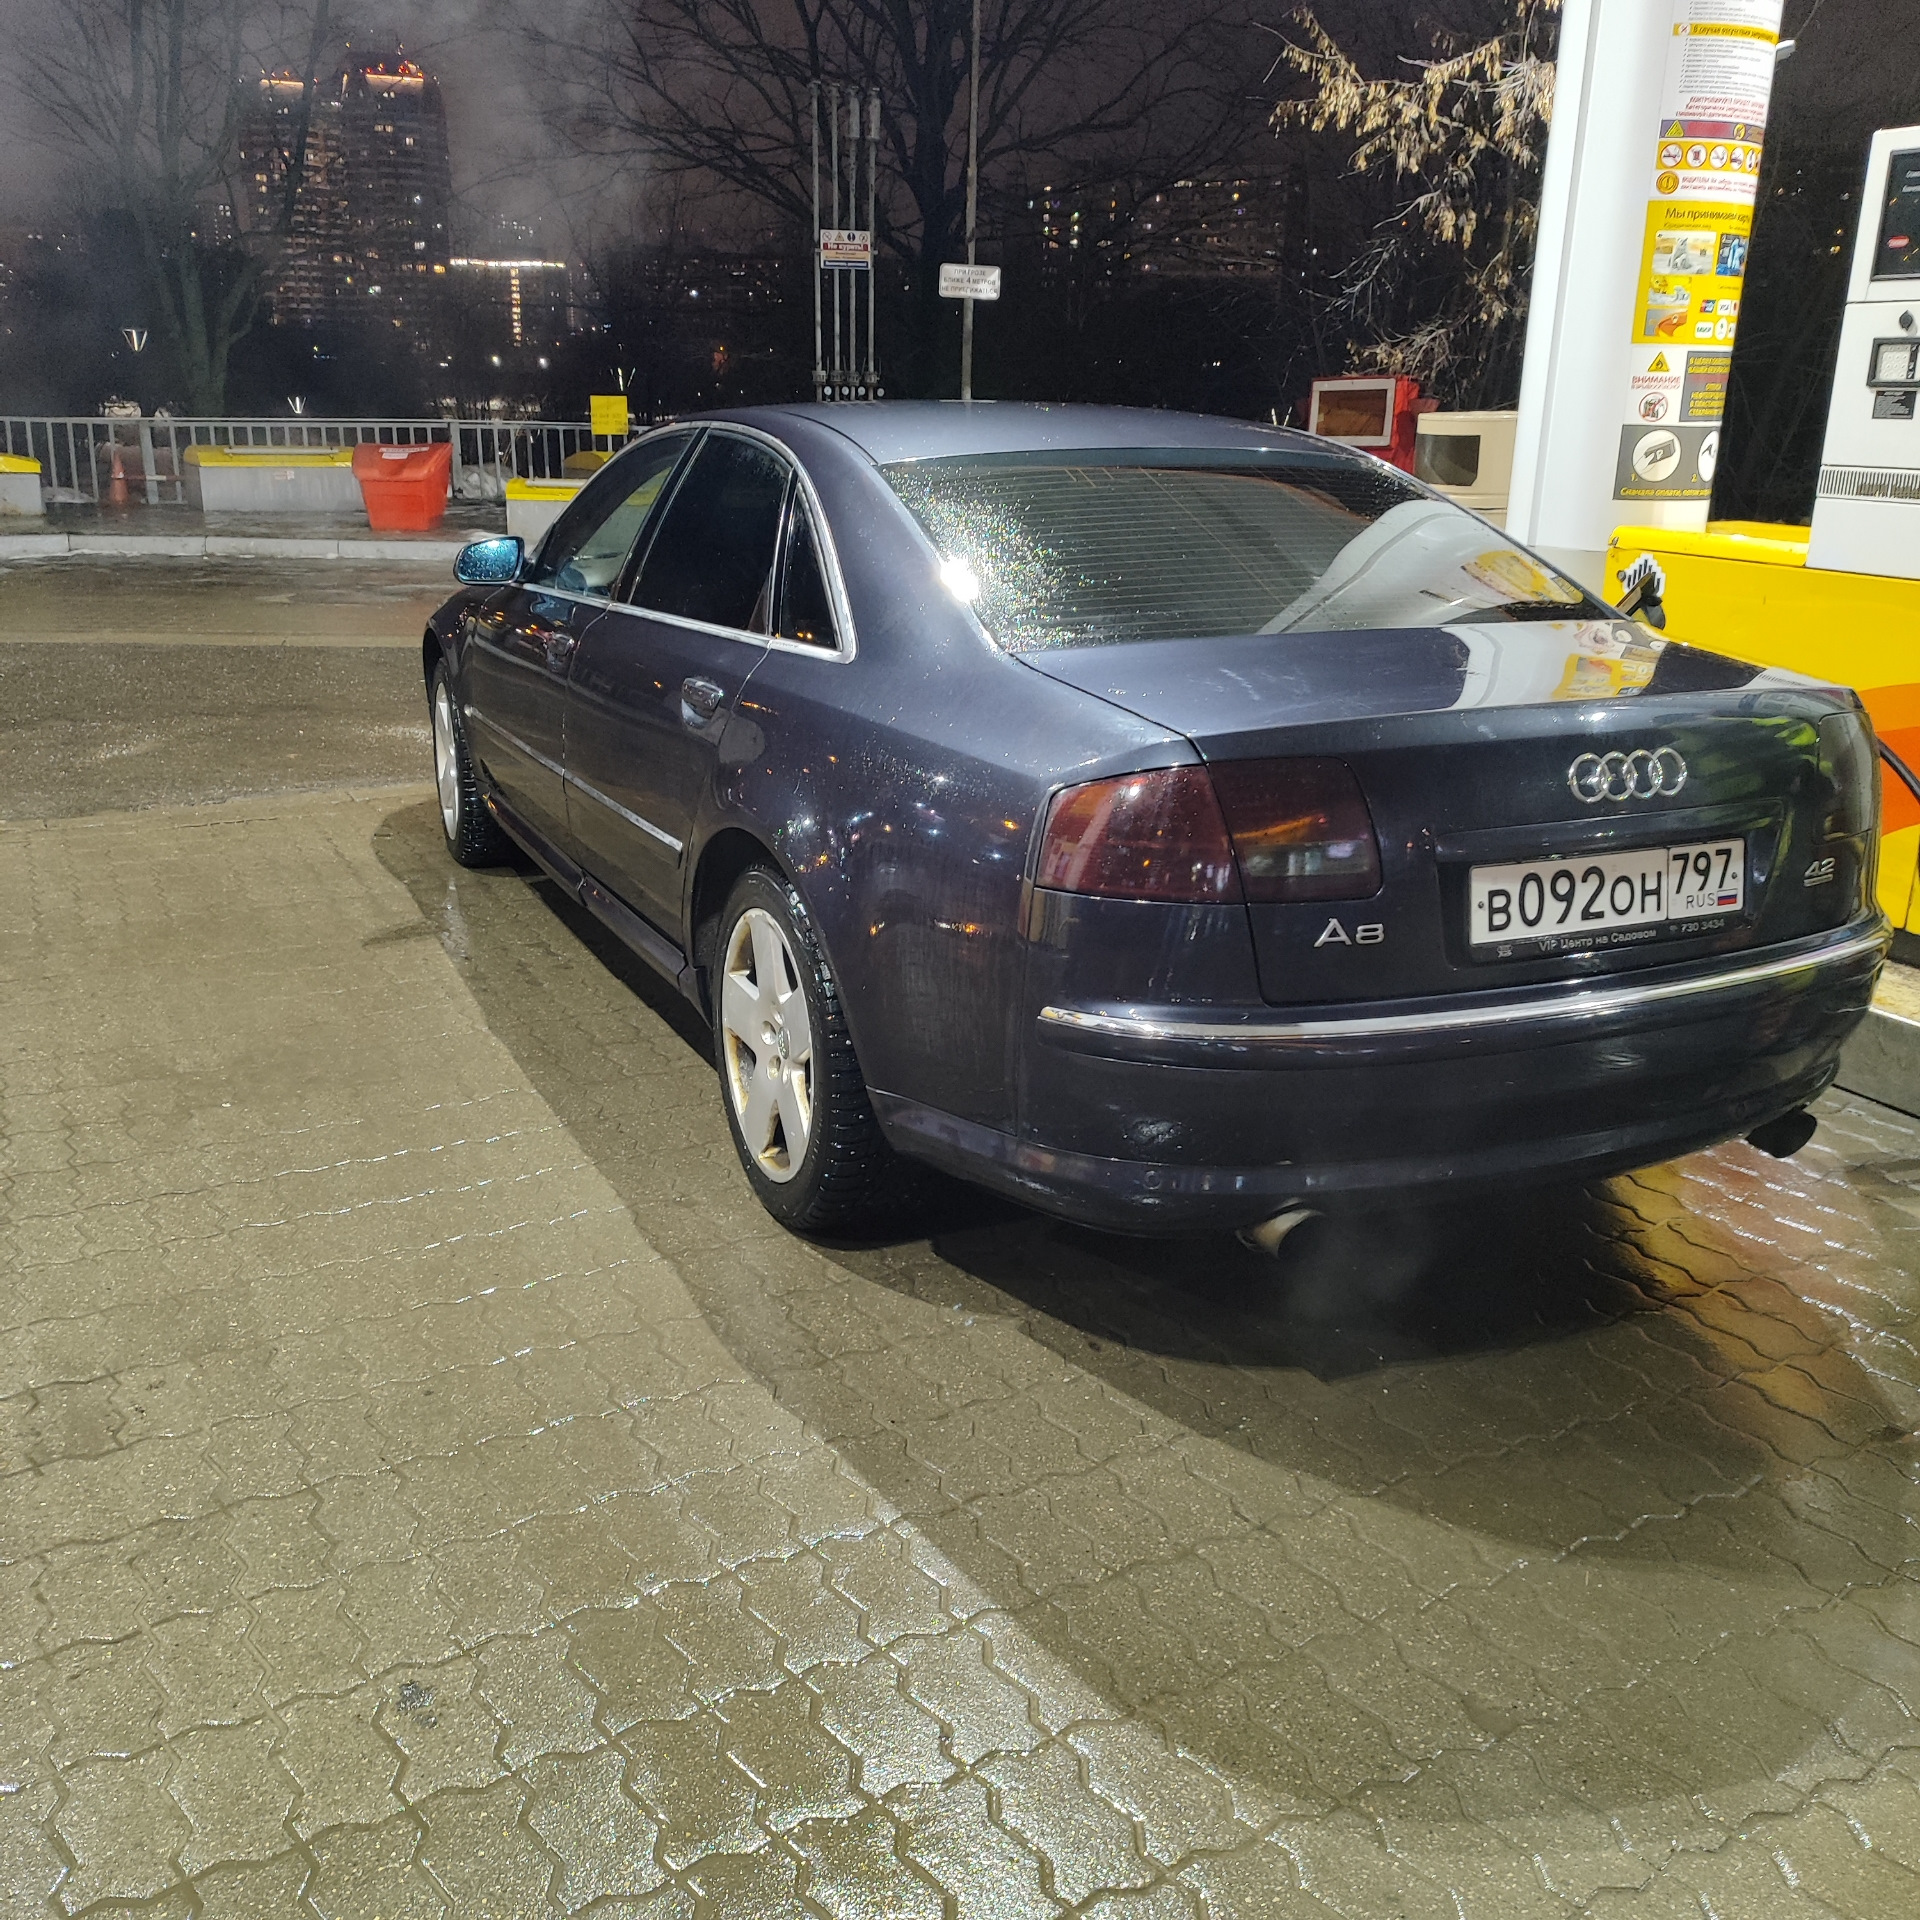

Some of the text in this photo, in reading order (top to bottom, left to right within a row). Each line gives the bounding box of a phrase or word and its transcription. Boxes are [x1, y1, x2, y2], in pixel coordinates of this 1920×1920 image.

[1665, 208, 1685, 219] Мы
[1488, 848, 1733, 932] В092ОН 797
[1686, 892, 1715, 910] RUS
[1313, 918, 1385, 948] A8
[1538, 919, 1725, 951] VIP Центр на Садовом 730 3434
